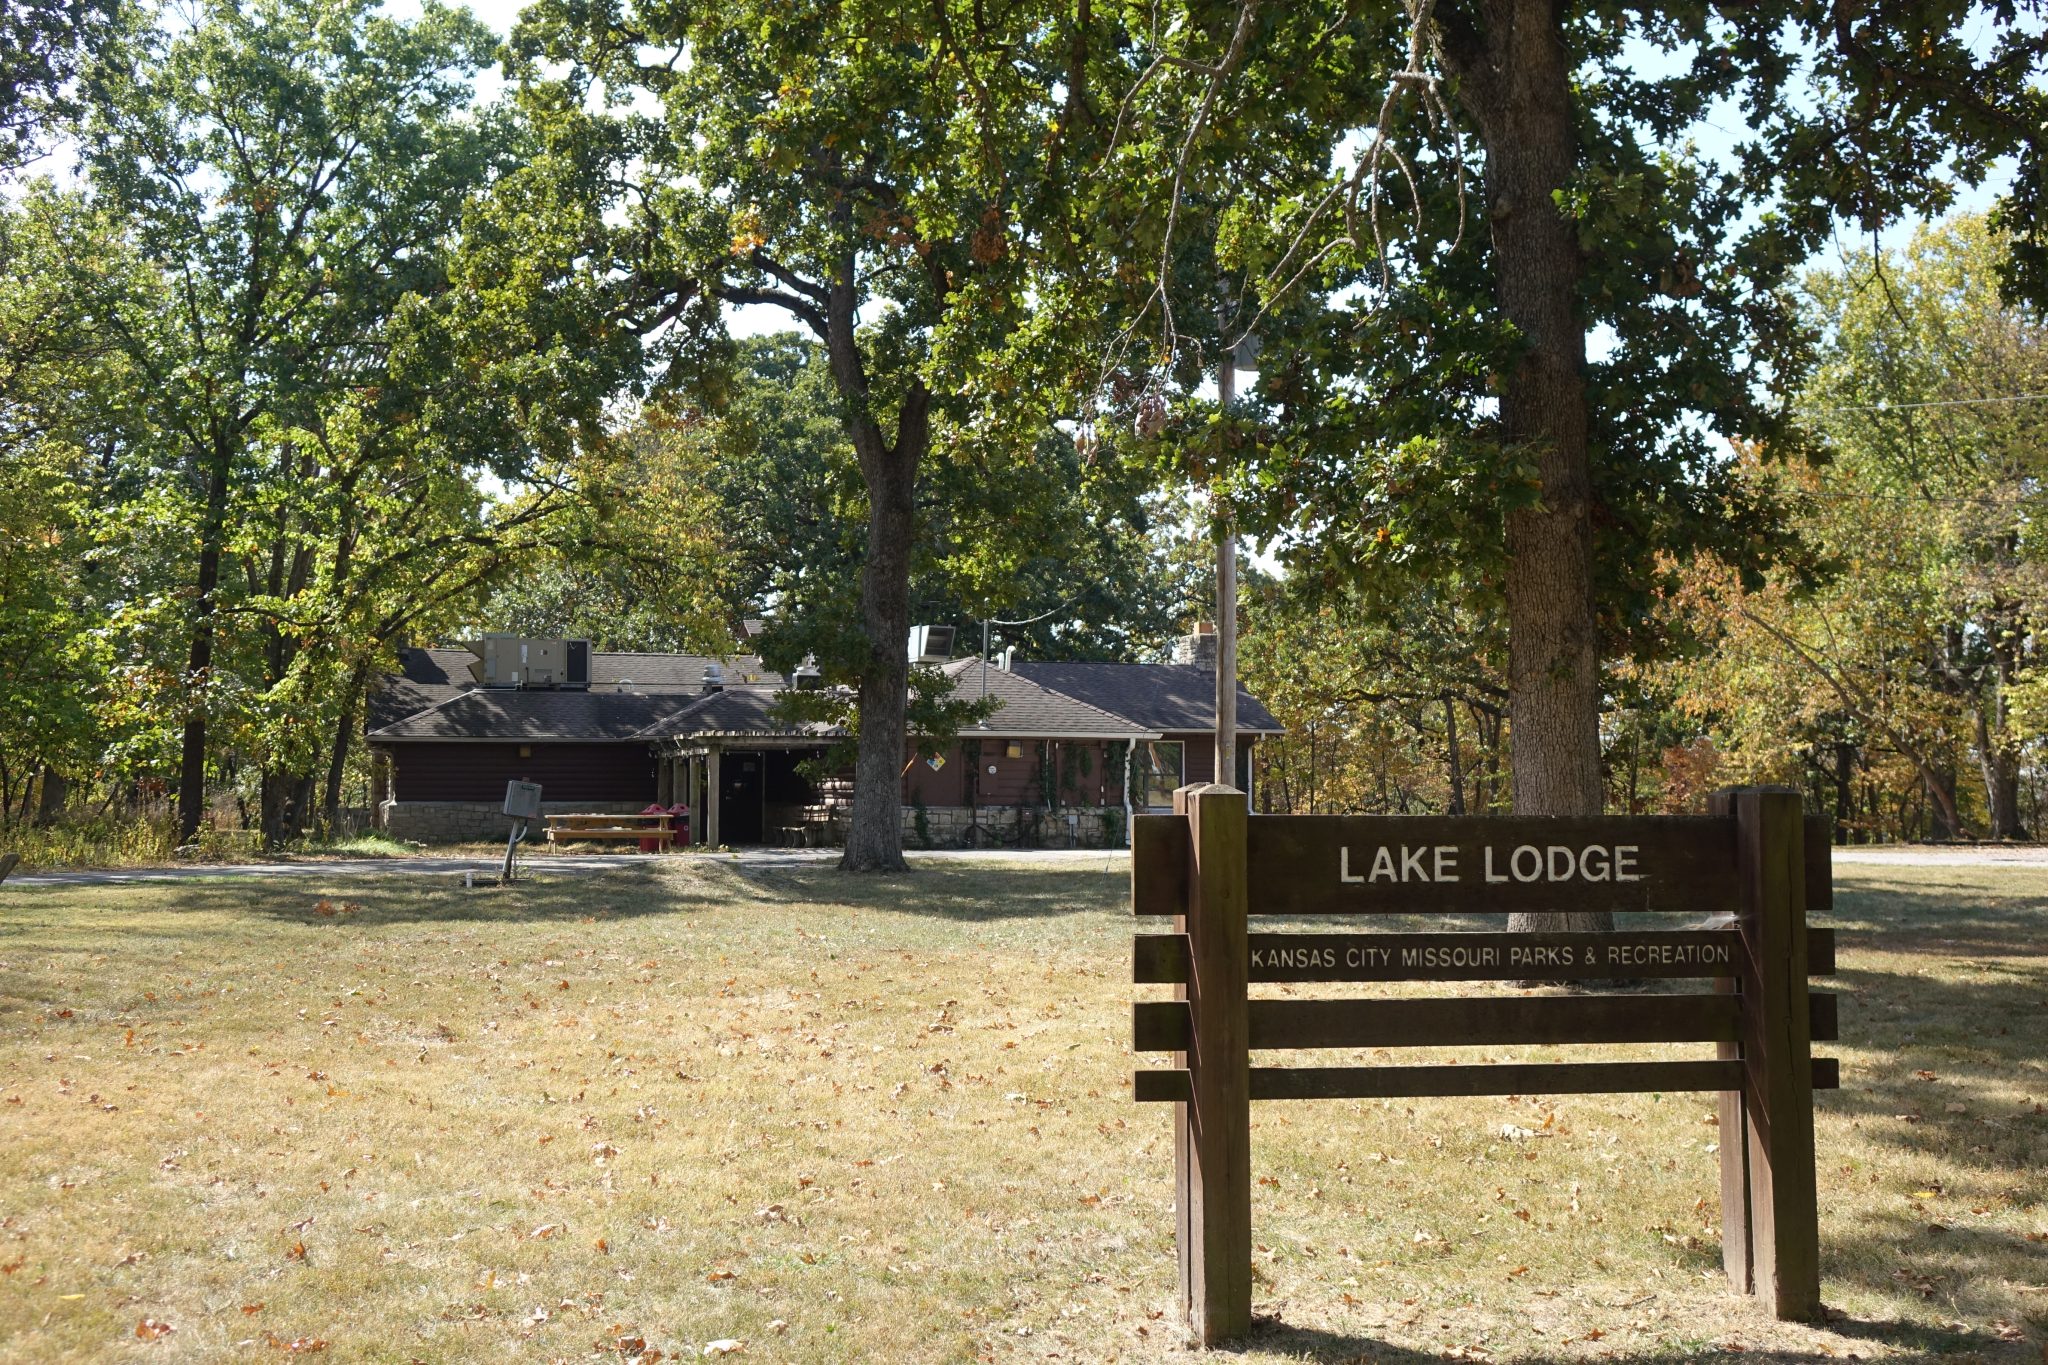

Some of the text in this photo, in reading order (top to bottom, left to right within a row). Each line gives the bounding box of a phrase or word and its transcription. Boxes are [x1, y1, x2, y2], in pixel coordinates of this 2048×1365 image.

[1340, 845, 1640, 882] LAKE LODGE
[1252, 944, 1729, 968] KANSAS CITY MISSOURI PARKS & RECREATION
